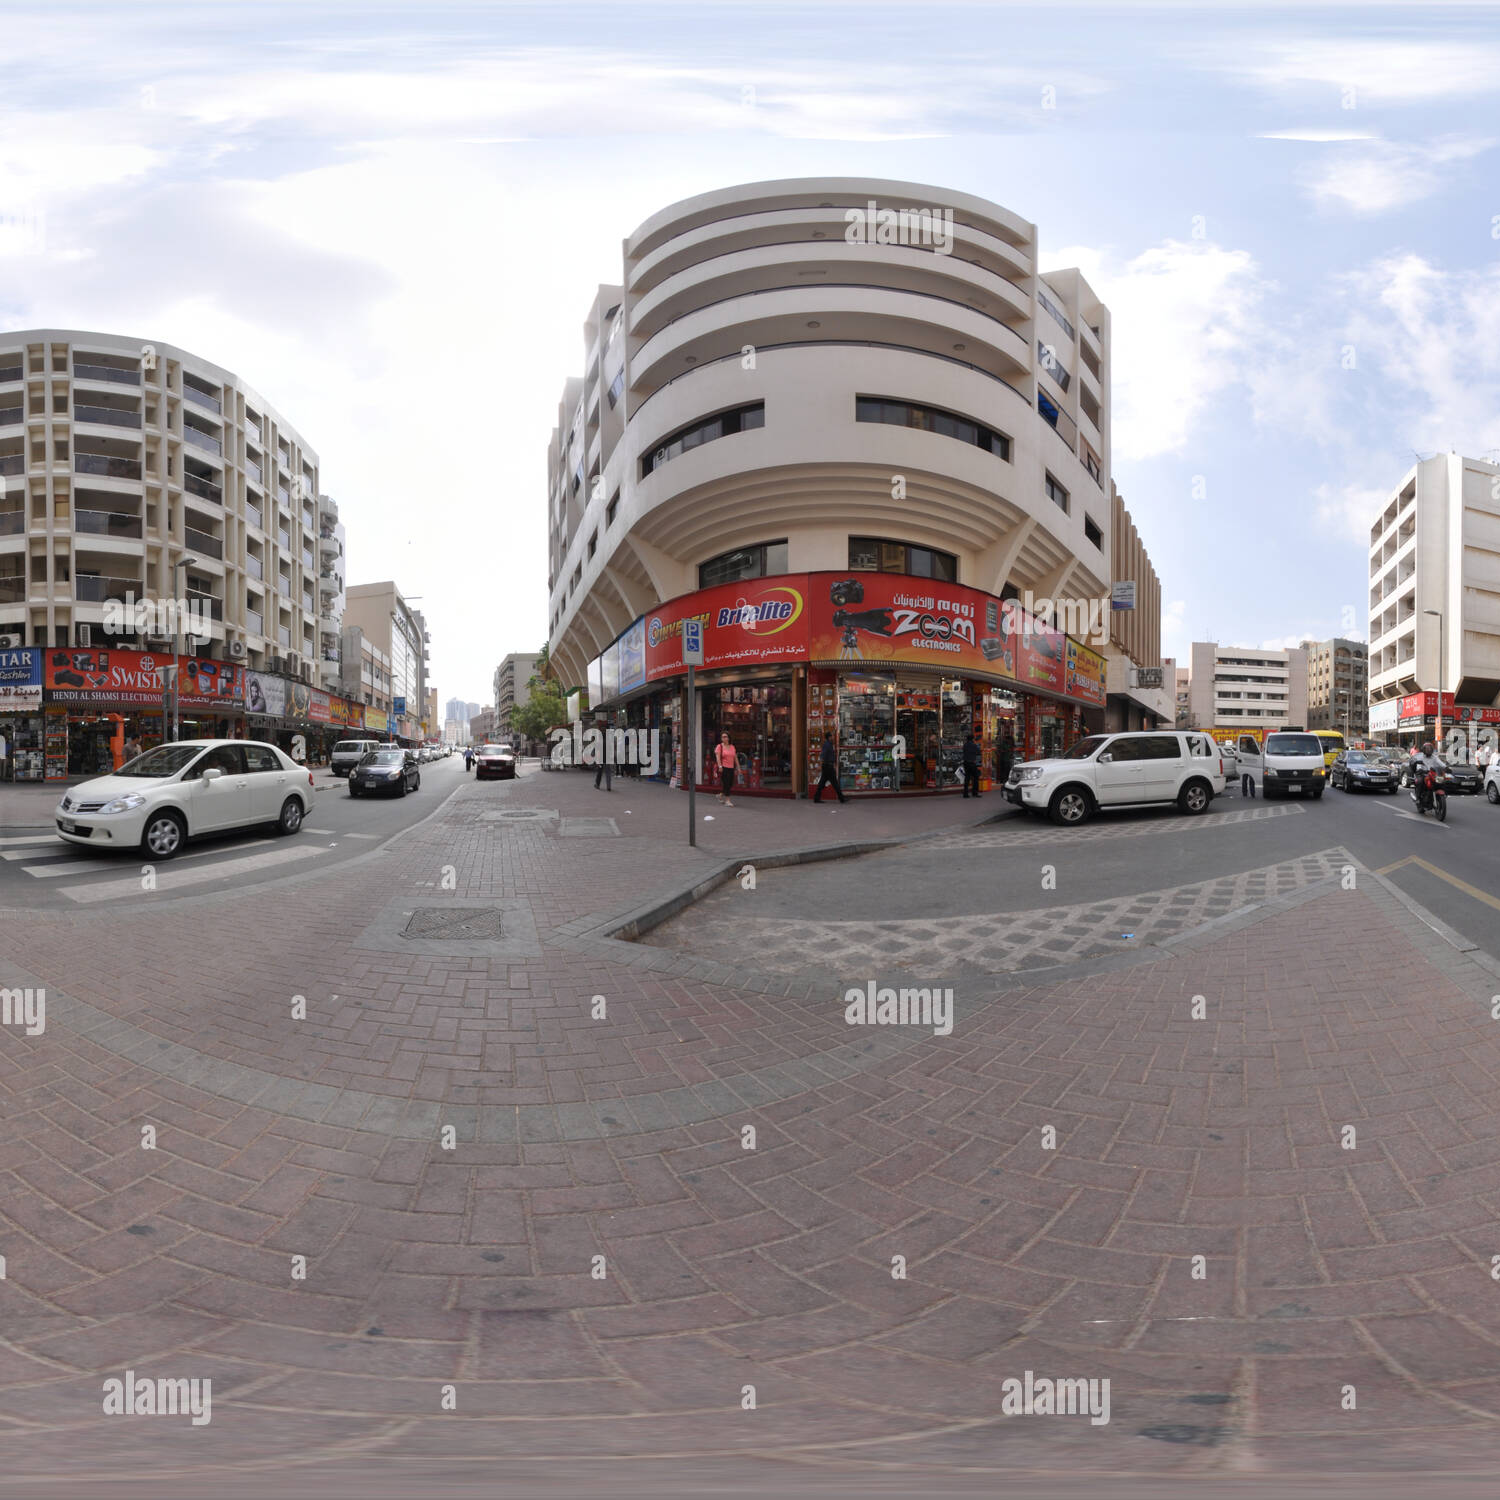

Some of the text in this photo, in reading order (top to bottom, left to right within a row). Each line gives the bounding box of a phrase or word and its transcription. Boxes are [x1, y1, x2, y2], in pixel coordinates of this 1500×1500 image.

[937, 599, 975, 618] زووم
[688, 624, 698, 636] P
[911, 638, 961, 653] ELECTRONICS
[52, 691, 78, 700] HENDI
[80, 691, 91, 700] AL
[91, 692, 120, 701] SHAMSI
